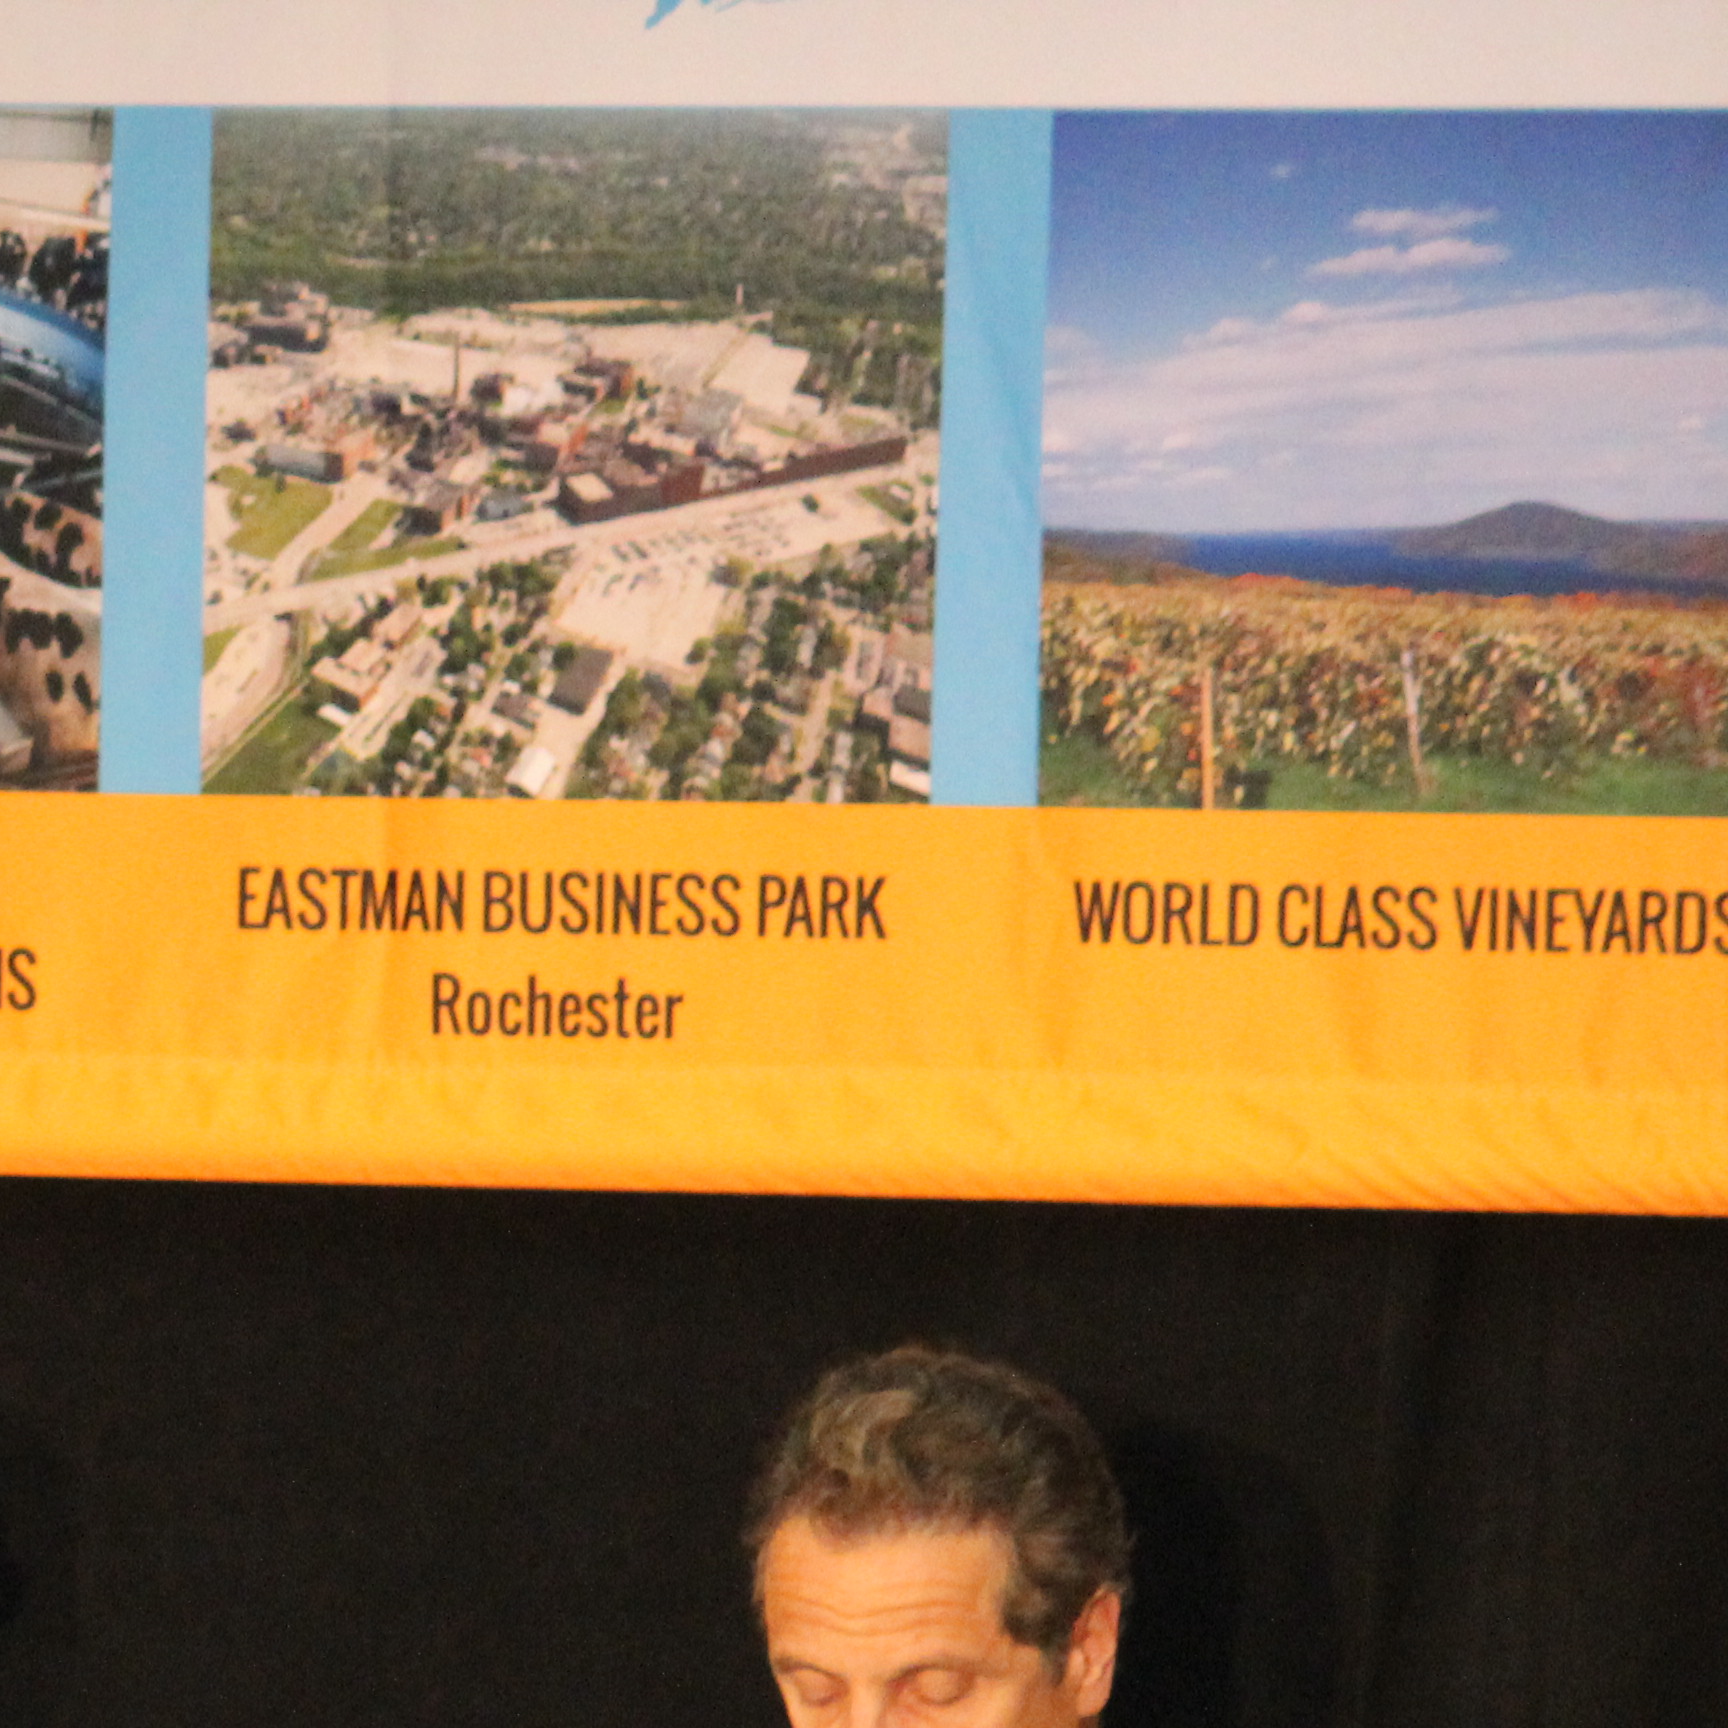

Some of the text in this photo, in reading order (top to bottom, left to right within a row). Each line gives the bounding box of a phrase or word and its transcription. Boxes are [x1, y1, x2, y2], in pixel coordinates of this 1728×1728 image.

[239, 867, 885, 938] EASTMAN BUSINESS PARK
[1075, 882, 1728, 955] WORLD CLASS VINEYARDS
[432, 973, 683, 1038] Rochester
